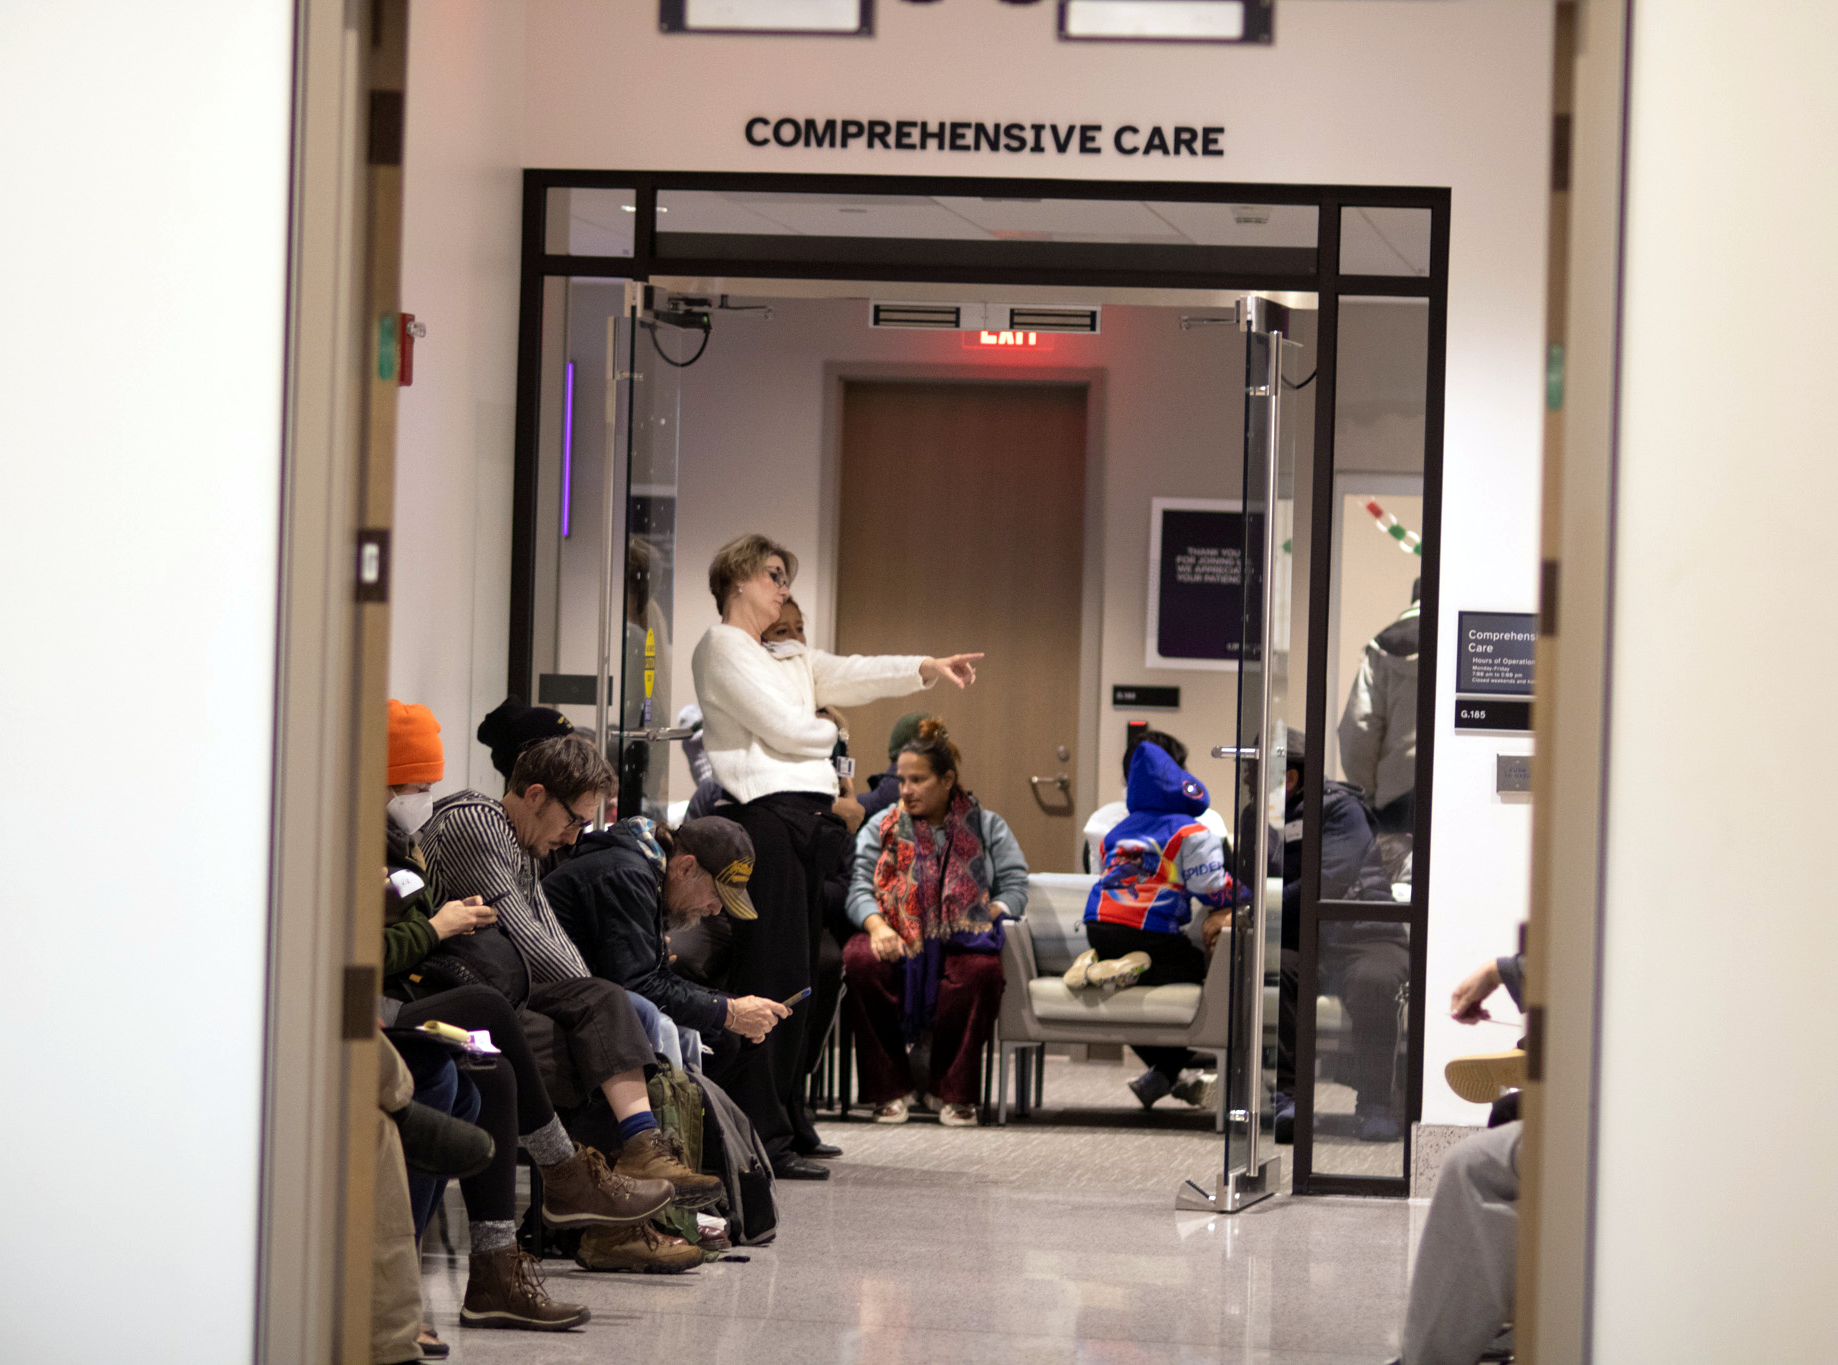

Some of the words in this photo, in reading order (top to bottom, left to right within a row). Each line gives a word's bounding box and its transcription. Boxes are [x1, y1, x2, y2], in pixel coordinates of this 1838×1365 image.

[745, 116, 1102, 155] COMPREHENSIVE
[1113, 124, 1226, 157] CARE
[1468, 642, 1494, 653] Care
[1460, 709, 1486, 719] G.185
